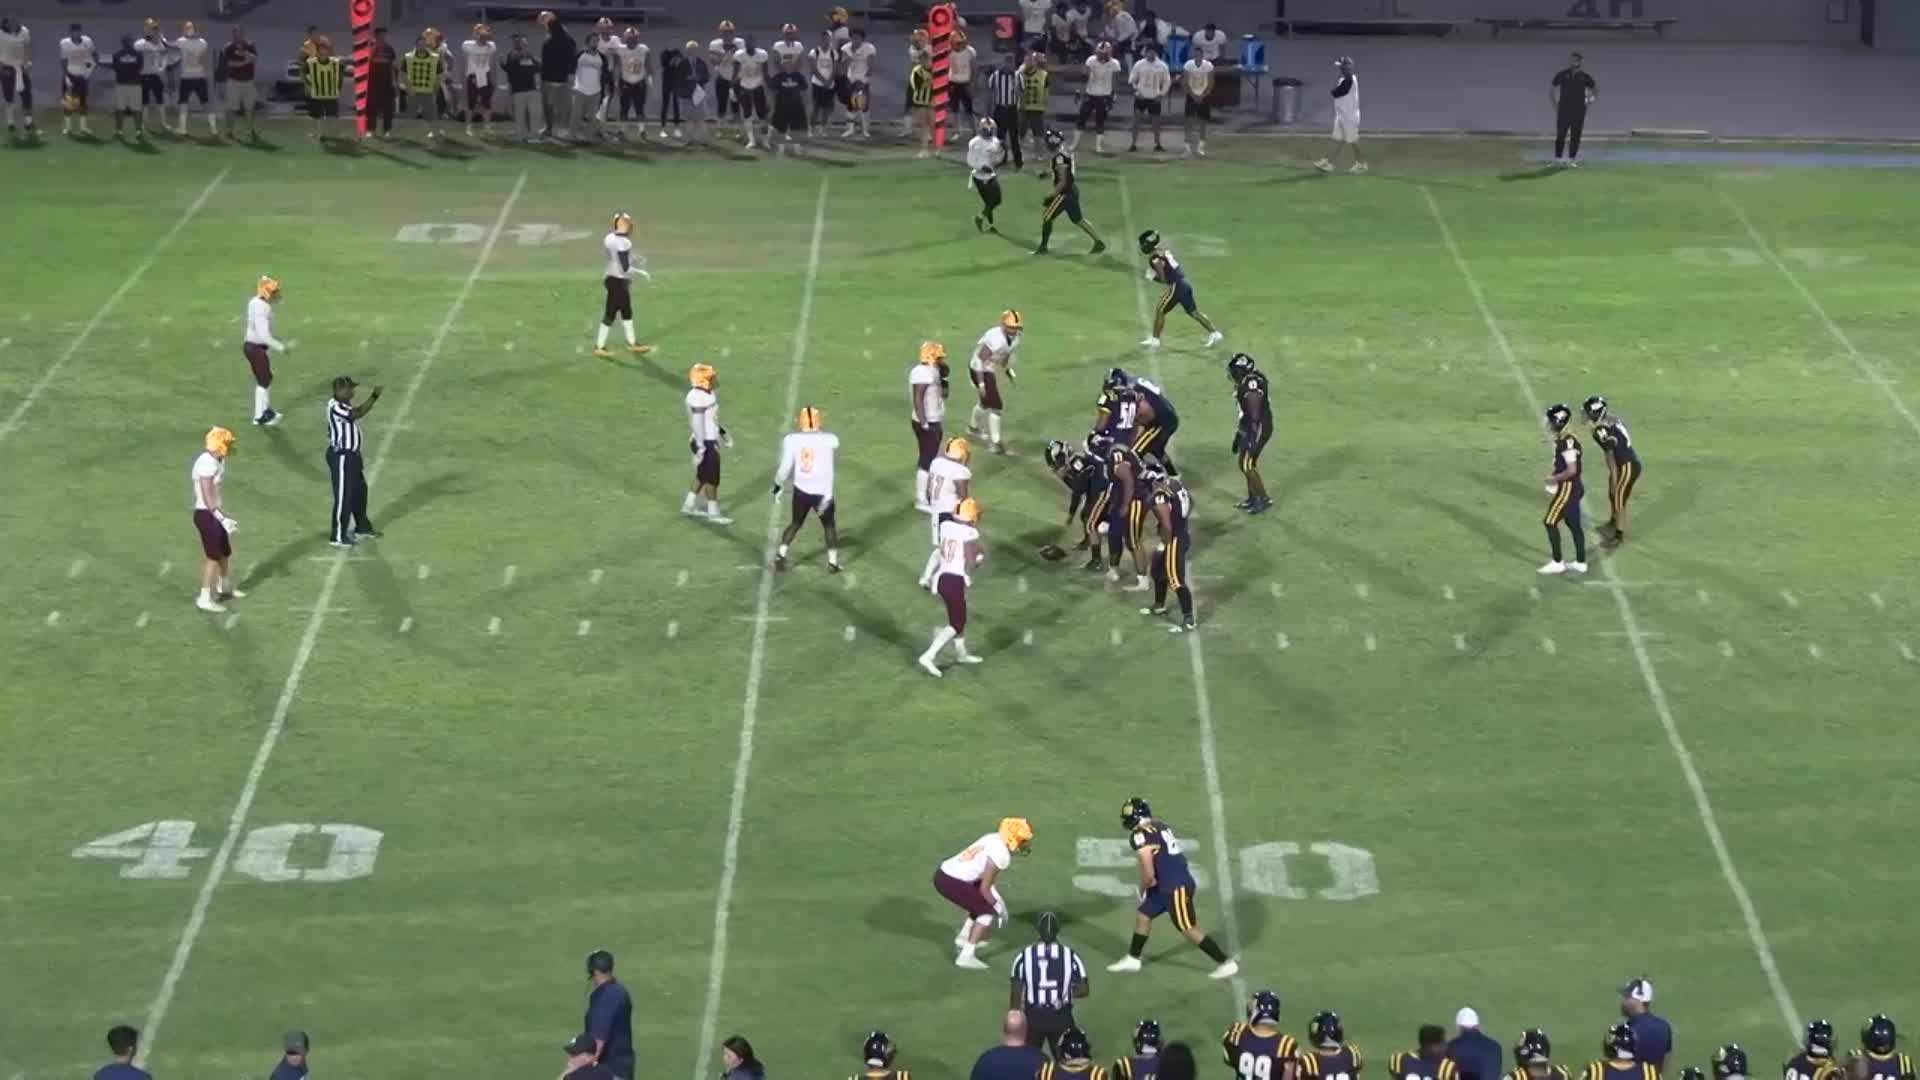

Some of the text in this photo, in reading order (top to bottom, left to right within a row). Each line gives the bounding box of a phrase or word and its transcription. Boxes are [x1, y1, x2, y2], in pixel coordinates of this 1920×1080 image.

[71, 820, 385, 882] 40
[1072, 837, 1380, 900] 50
[1038, 959, 1057, 987] L
